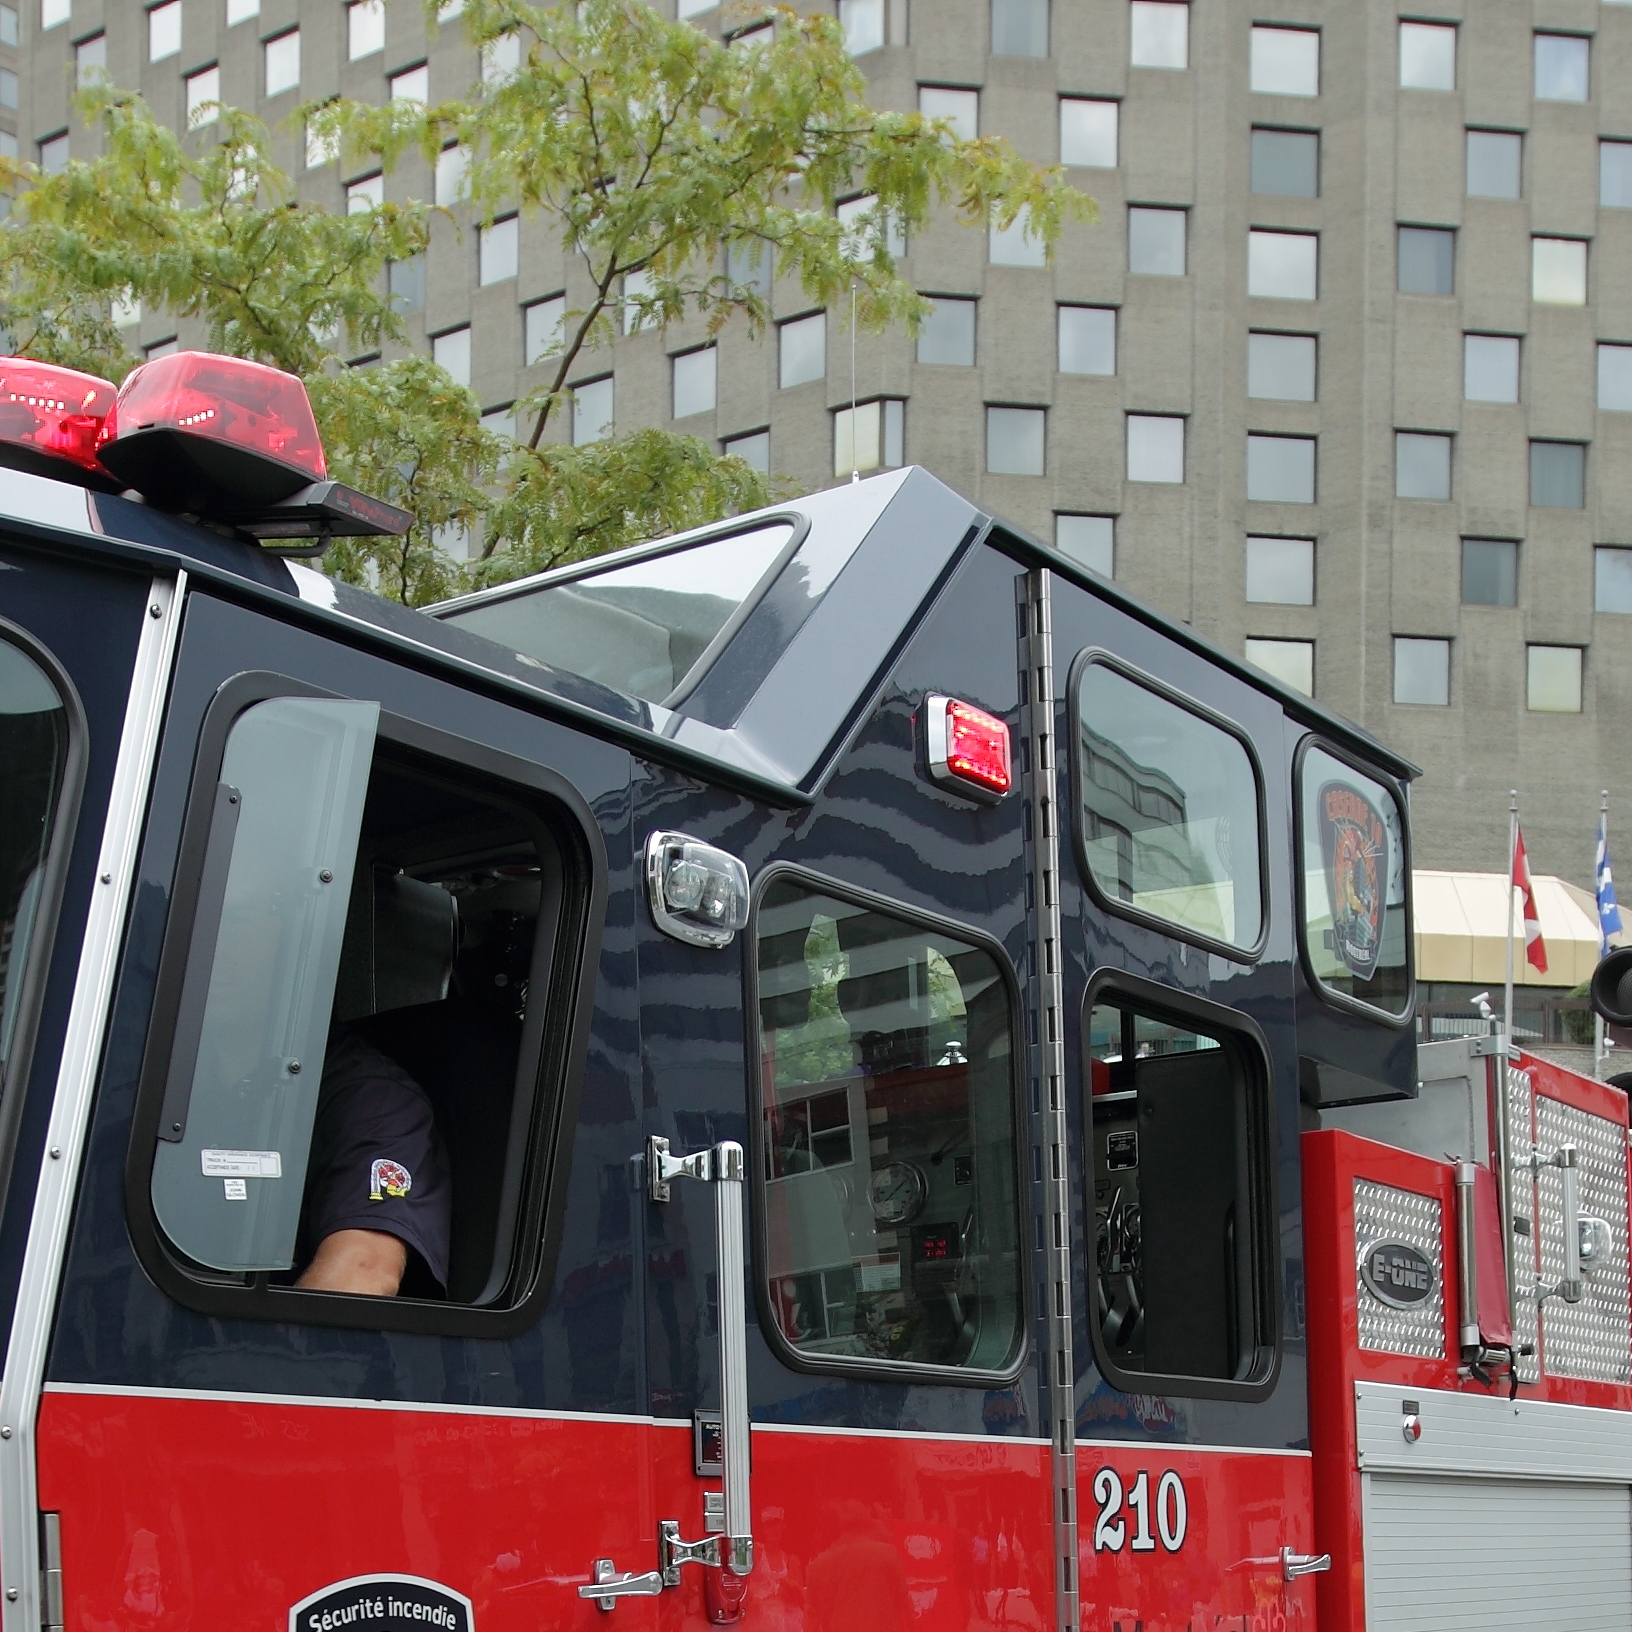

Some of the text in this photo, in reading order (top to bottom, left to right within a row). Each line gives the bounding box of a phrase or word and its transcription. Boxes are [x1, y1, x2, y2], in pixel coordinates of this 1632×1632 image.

[1372, 1253, 1428, 1291] E-ONE
[1092, 1465, 1187, 1554] 210
[388, 1596, 457, 1631] incendie
